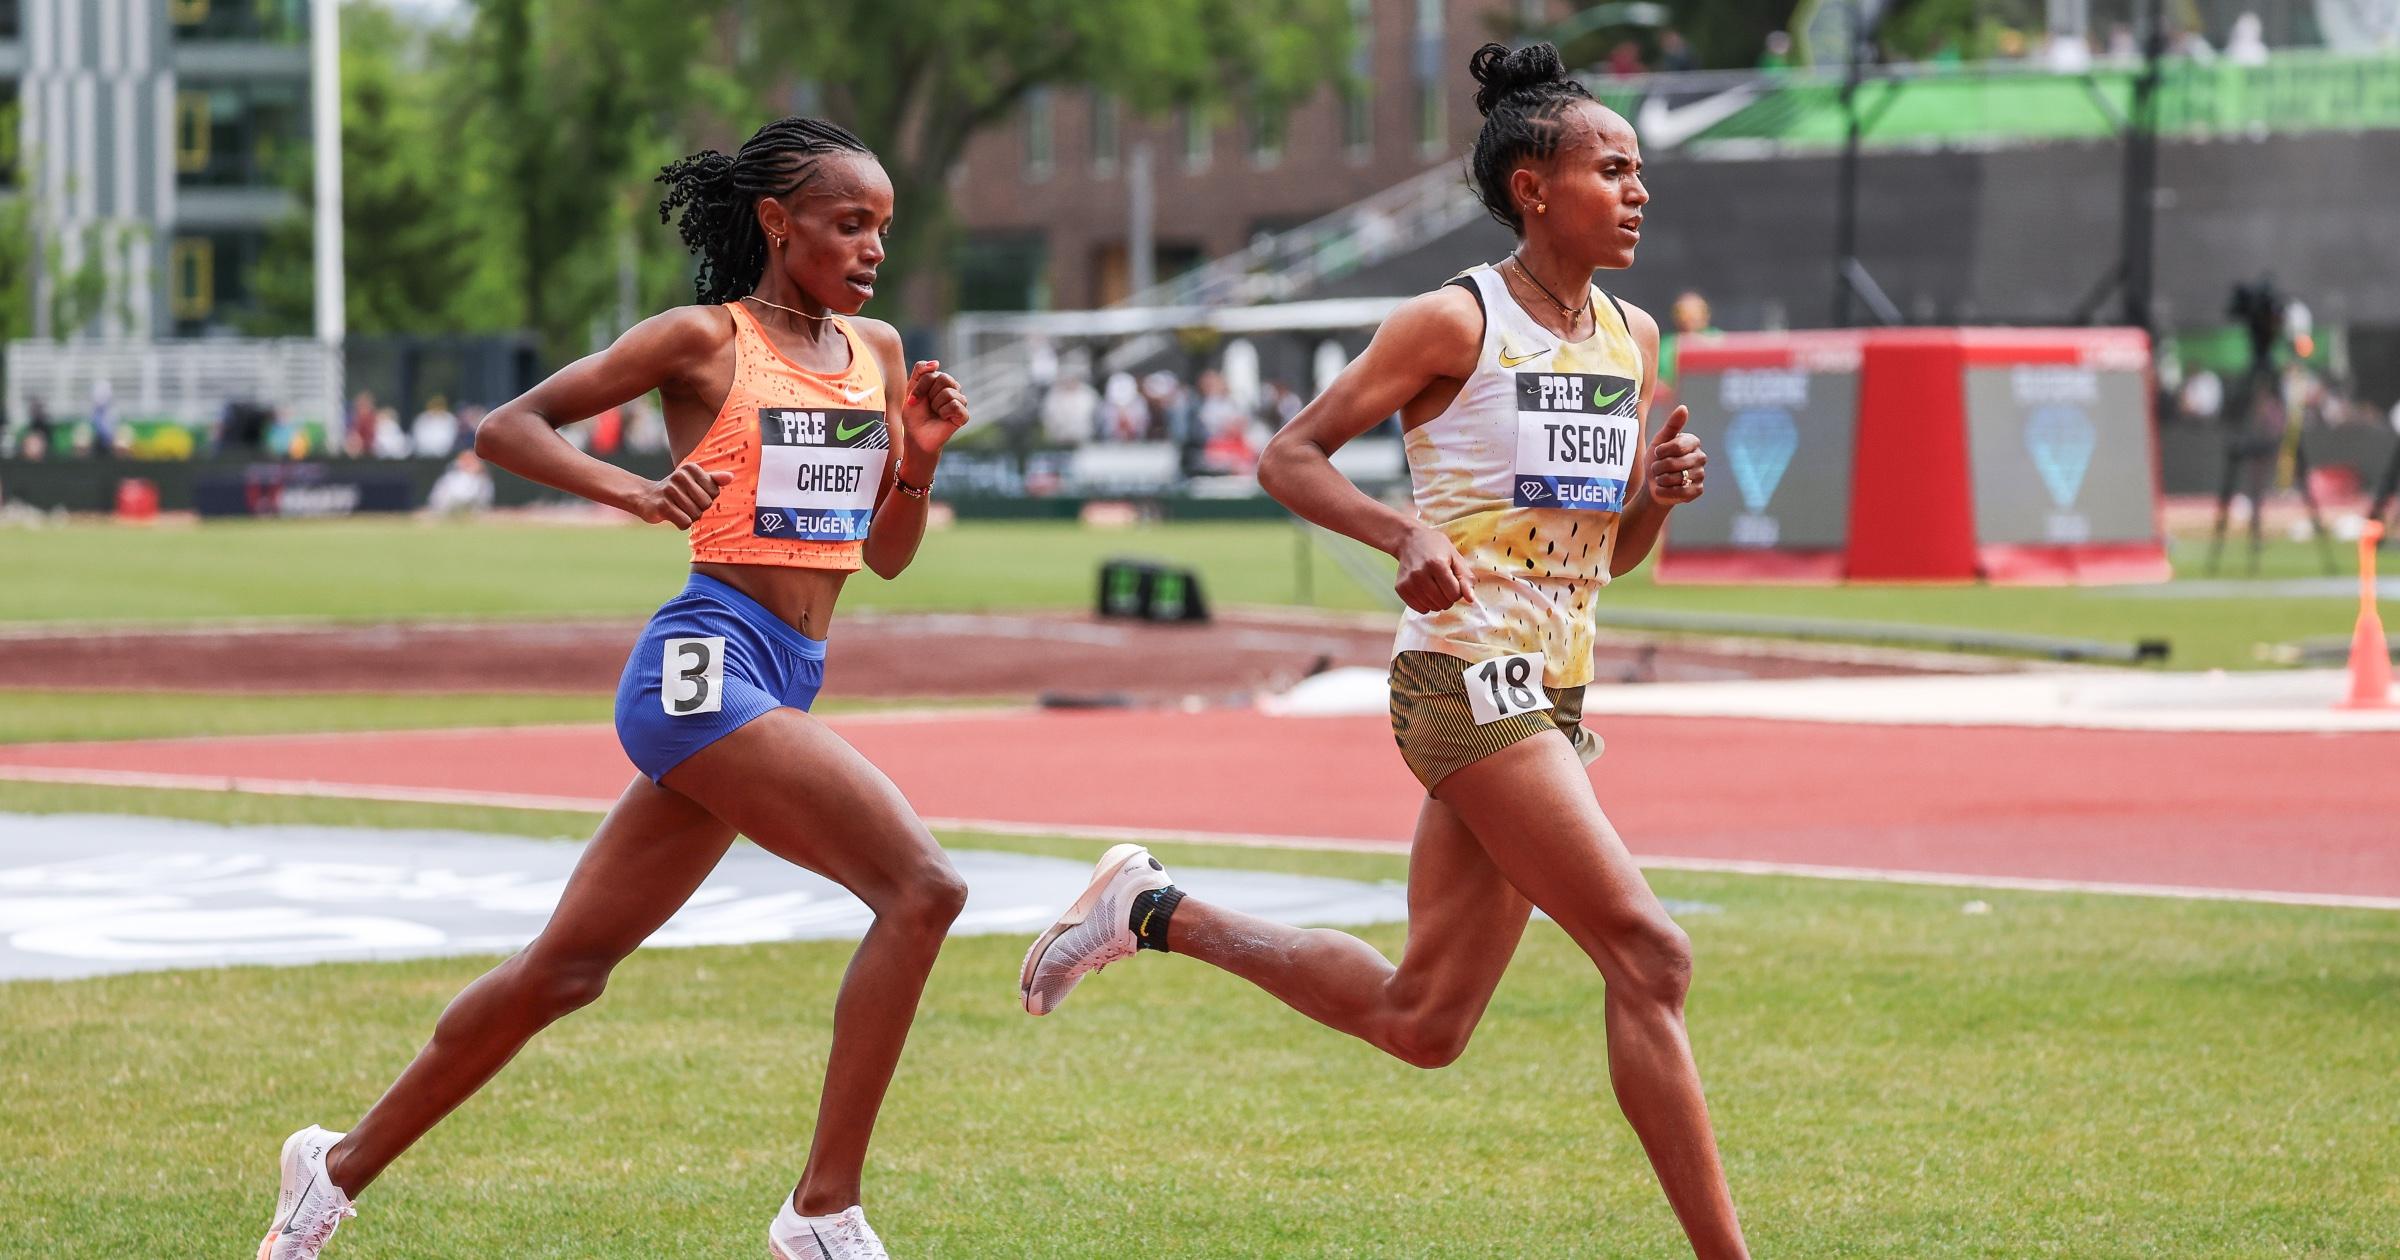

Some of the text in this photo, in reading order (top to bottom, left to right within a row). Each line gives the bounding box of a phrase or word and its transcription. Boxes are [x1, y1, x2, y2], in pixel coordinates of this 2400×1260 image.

[1539, 376, 1583, 410] PRE
[781, 412, 826, 444] PRE
[1544, 424, 1626, 466] TSEGAY
[797, 464, 863, 492] CHEBET
[674, 642, 711, 712] 3
[1479, 657, 1537, 715] 18
